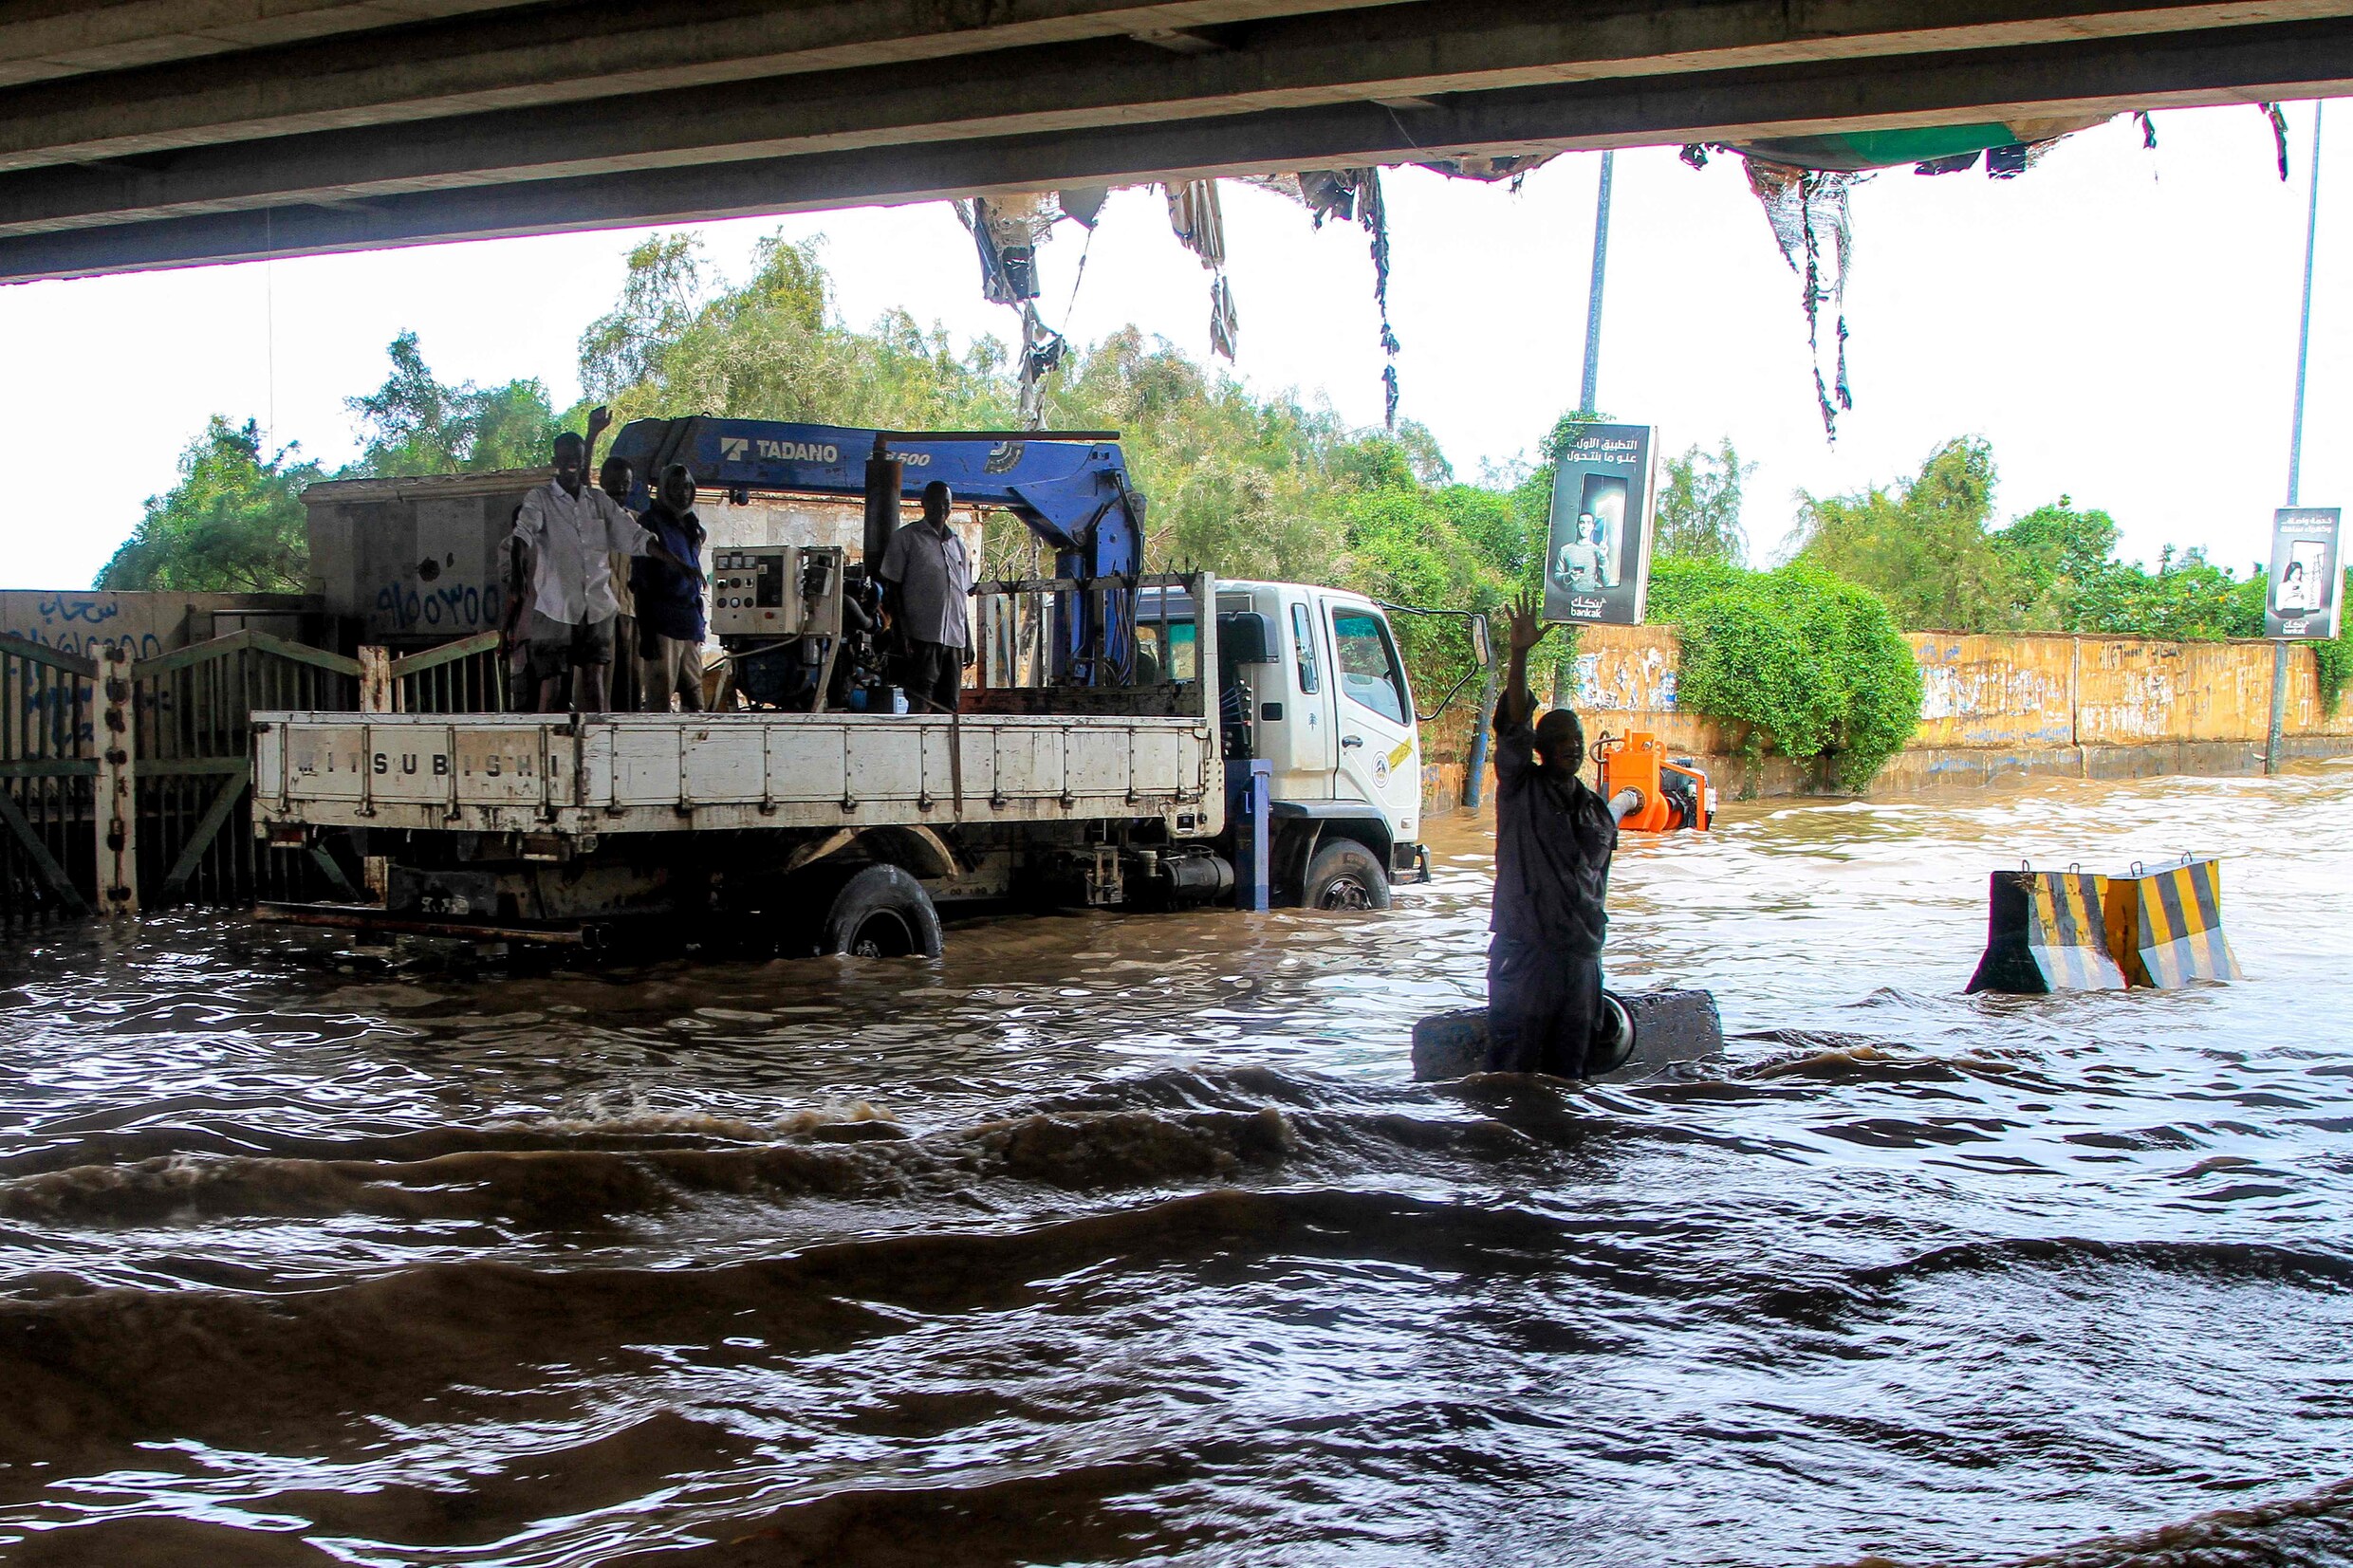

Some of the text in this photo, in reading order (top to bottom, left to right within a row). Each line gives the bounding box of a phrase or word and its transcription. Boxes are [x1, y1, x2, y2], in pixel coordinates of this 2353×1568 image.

[756, 439, 838, 464] TADANO
[1601, 439, 1638, 452] التطبيق
[1566, 451, 1602, 464] بنتحول
[1603, 452, 1615, 463] ما
[1570, 606, 1602, 618] bankak
